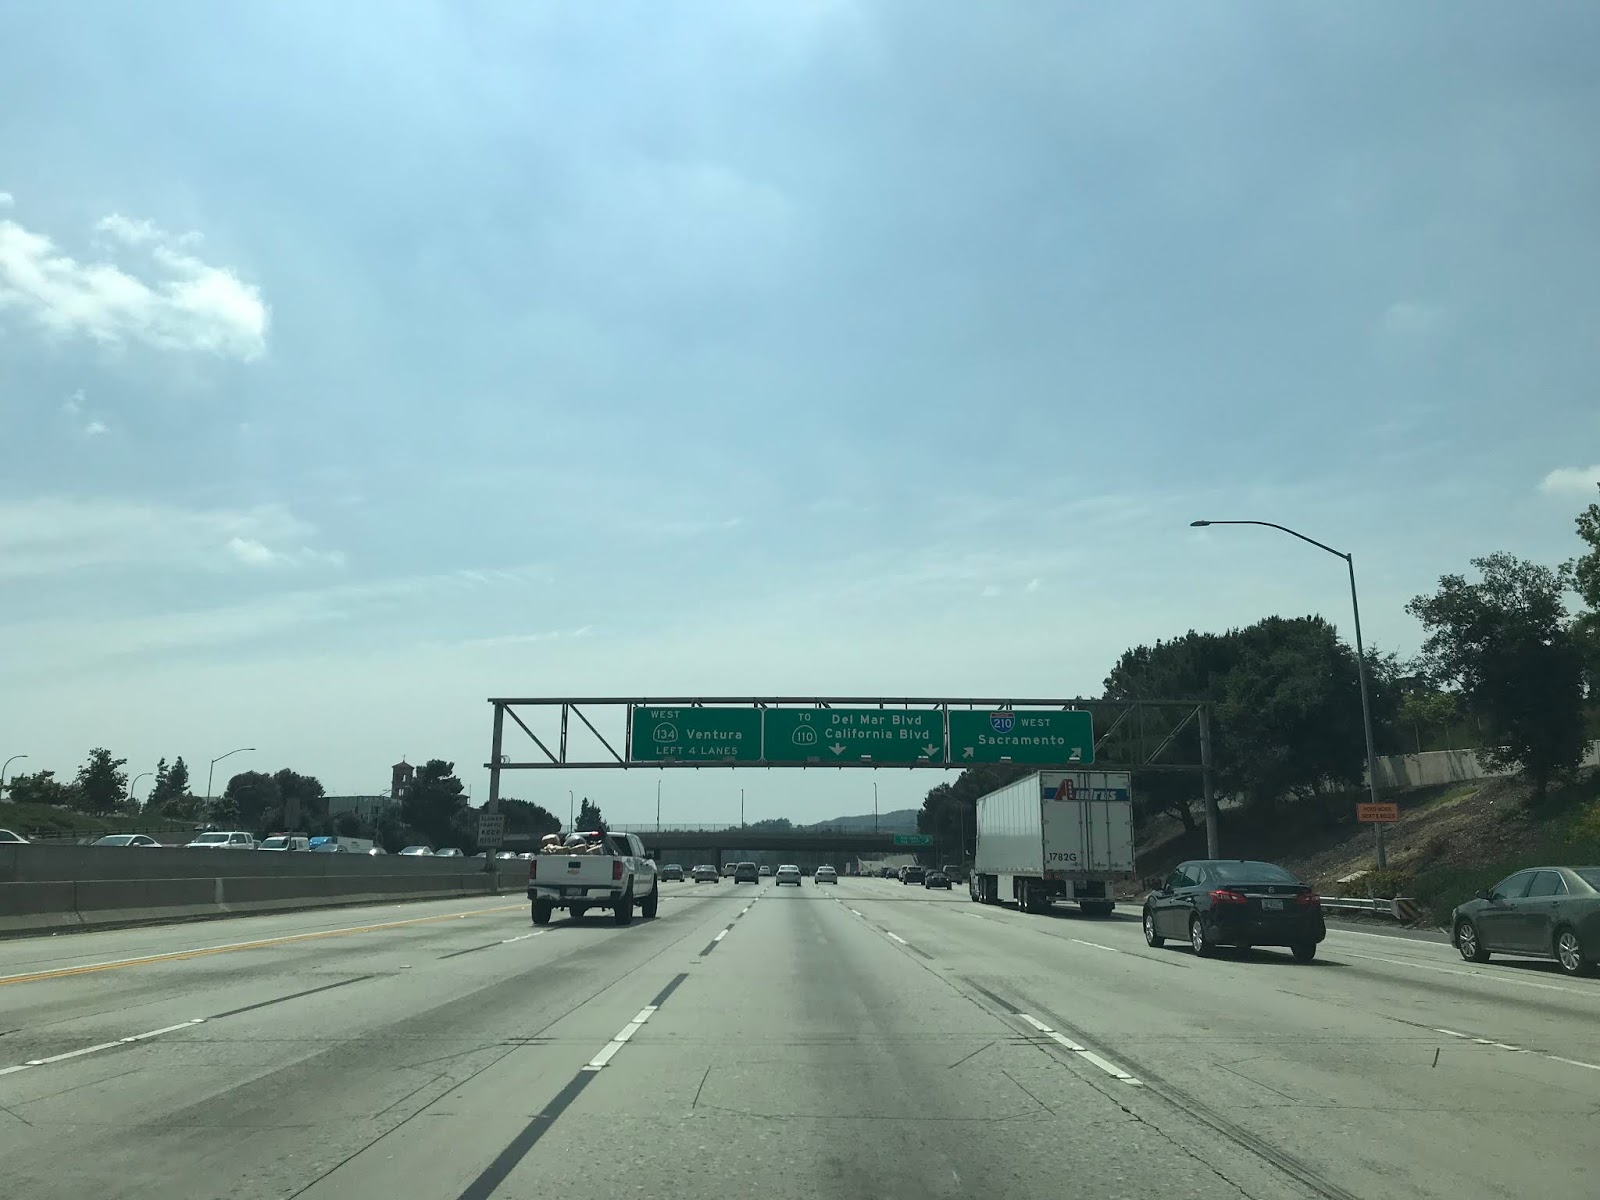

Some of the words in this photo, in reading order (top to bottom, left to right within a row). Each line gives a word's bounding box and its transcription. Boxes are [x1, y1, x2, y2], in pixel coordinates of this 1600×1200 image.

[798, 713, 811, 721] TO
[832, 714, 853, 724] Del
[860, 715, 885, 725] Mar
[892, 715, 922, 725] Blvd
[1021, 718, 1051, 726] WEST
[994, 718, 1012, 729] 210
[656, 730, 676, 740] 134
[686, 729, 742, 740] Ventura
[797, 732, 813, 742] 110
[824, 728, 892, 739] California
[900, 730, 930, 740] Blvd
[978, 734, 1065, 745] Sacramento
[656, 746, 683, 754] LEFT
[688, 746, 696, 754] 4
[701, 746, 738, 755] LANES
[1048, 852, 1077, 862] 1782G
